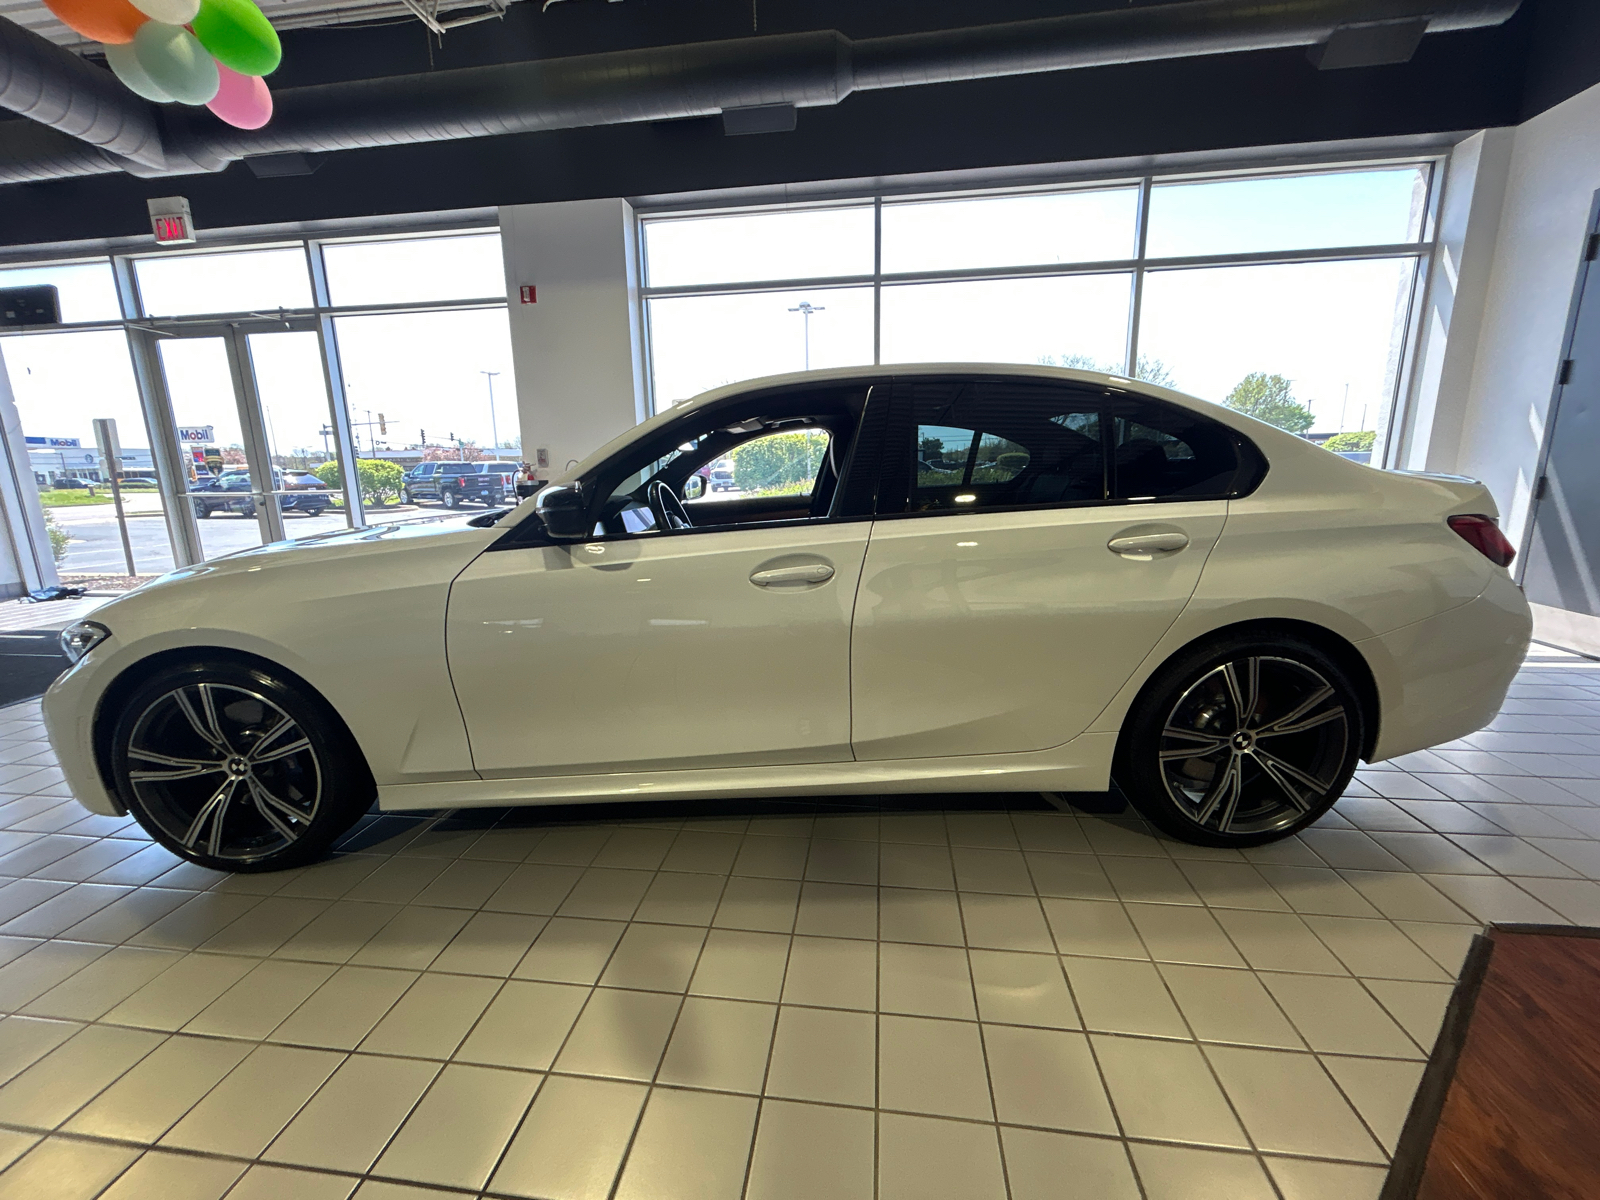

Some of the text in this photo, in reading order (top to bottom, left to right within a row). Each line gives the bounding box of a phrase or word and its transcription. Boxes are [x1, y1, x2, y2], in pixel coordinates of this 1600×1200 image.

[155, 216, 185, 241] EXIT
[180, 429, 209, 440] Mobil
[50, 439, 77, 447] Mobil
